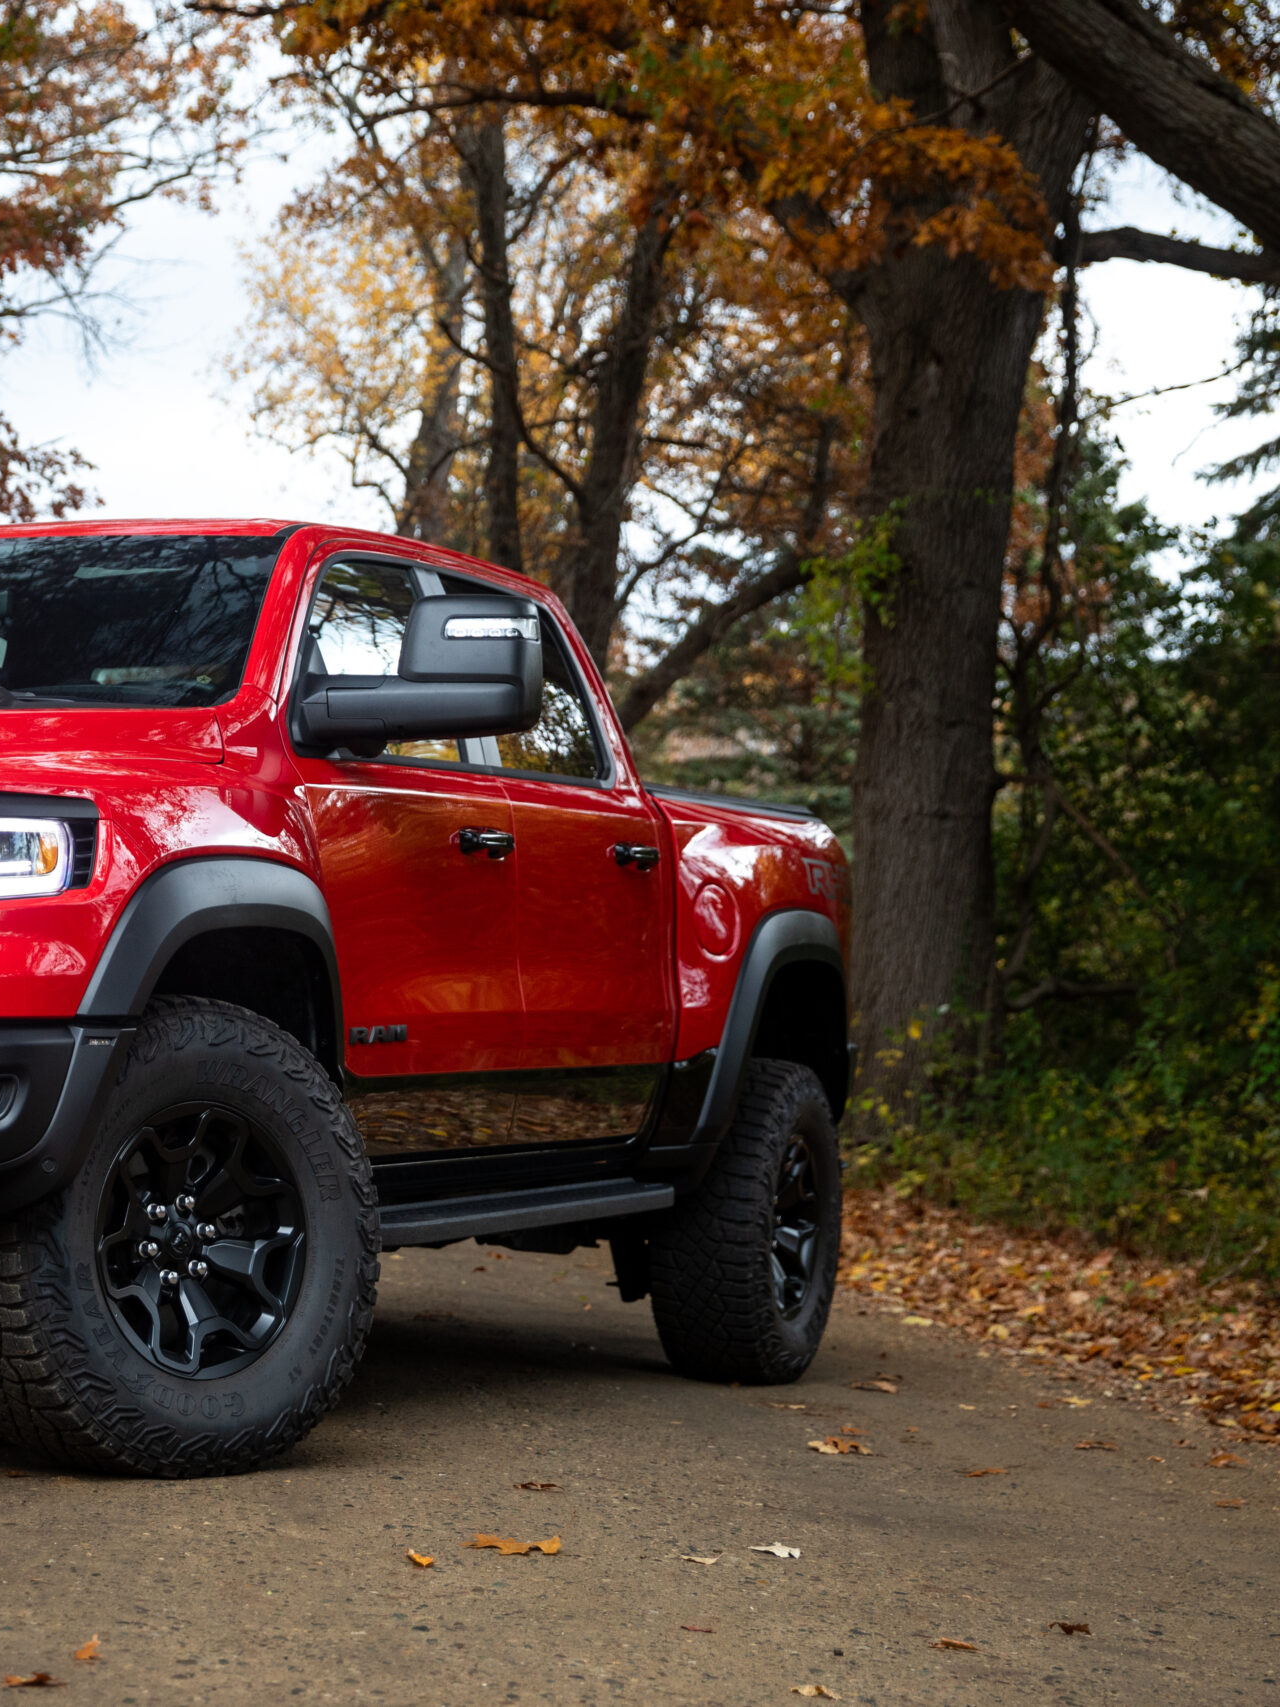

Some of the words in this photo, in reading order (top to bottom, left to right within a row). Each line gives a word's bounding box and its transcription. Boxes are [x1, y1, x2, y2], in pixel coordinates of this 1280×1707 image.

[348, 1023, 408, 1046] RAM
[196, 1059, 343, 1202] WRANGLER
[75, 1262, 246, 1419] GOODYEAR
